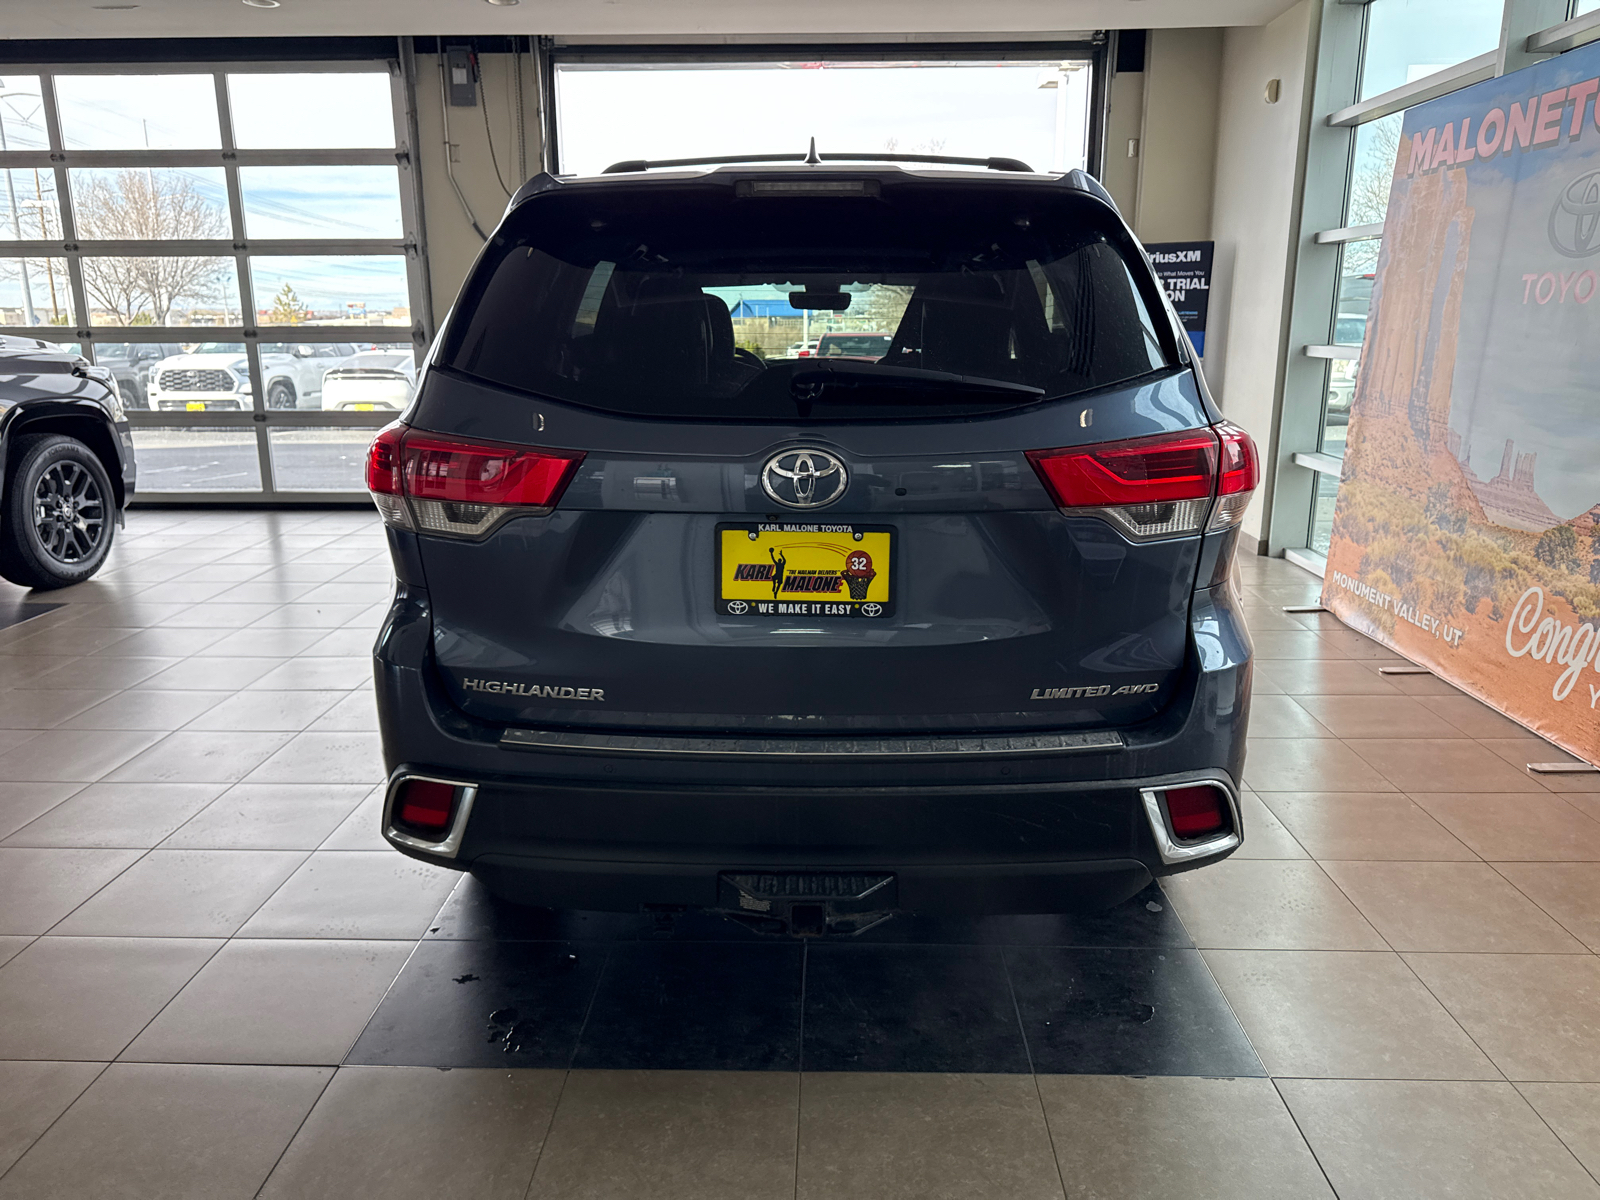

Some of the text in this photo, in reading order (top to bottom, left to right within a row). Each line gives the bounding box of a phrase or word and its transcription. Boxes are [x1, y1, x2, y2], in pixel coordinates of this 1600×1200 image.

[1167, 277, 1209, 290] TRIAL
[758, 523, 853, 533] KARL MALONE TOYOTA
[851, 557, 867, 570] 32
[733, 564, 775, 581] KARL
[781, 575, 845, 593] MALONE
[758, 602, 851, 615] WE MAKE IT EASY
[1332, 570, 1463, 646] MONUMENT VALLEY, UT
[462, 677, 606, 702] HIGHLANDER
[1030, 683, 1160, 700] LIMITED AWD
